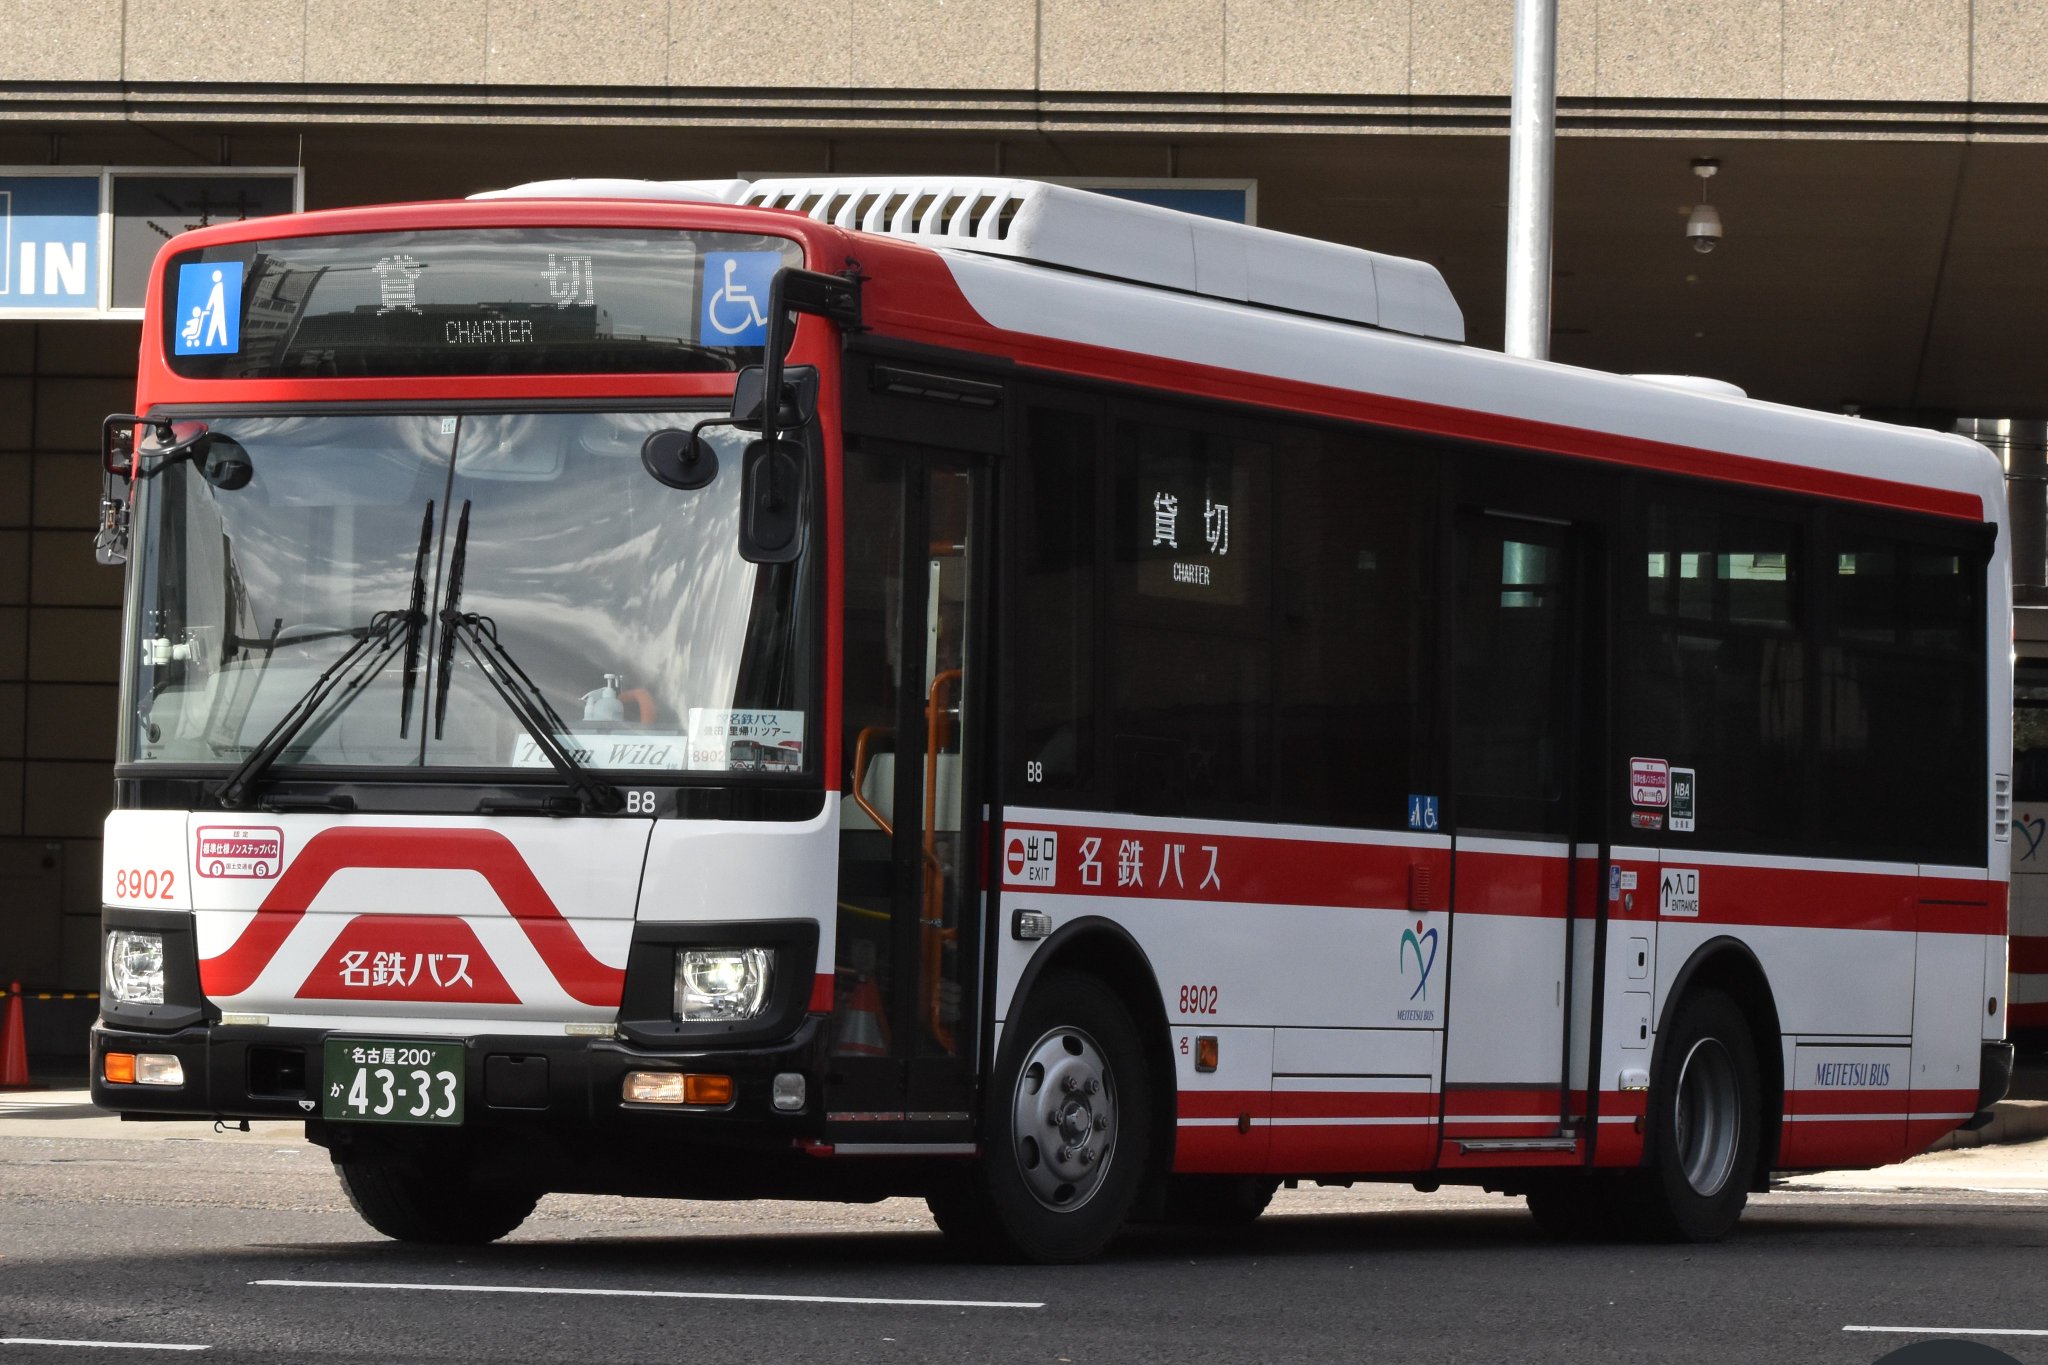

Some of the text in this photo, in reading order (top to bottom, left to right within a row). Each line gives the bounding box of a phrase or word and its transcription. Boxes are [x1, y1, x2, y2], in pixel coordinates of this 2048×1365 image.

[20, 242, 86, 295] IN
[446, 319, 534, 344] CHARTER
[1173, 562, 1210, 585] CHARTER
[730, 714, 778, 725] 名鉄バス
[608, 743, 672, 765] Wild
[1027, 761, 1042, 783] B8
[1674, 783, 1690, 797] NBA
[627, 791, 656, 813] B8
[203, 843, 277, 855] 標準仕様ノンステップバス
[1027, 836, 1054, 861] 出口
[1029, 867, 1050, 881] EXIT
[1078, 837, 1220, 891] 名鉄バス
[116, 869, 174, 899] 8902
[1675, 874, 1695, 895] 入口
[1672, 900, 1698, 912] ENTRANCE
[339, 950, 473, 988] 名鉄バス
[1179, 985, 1218, 1014] 8902
[1815, 1063, 1890, 1086] MEITETSU BUS
[330, 1067, 457, 1118] か 43-33
